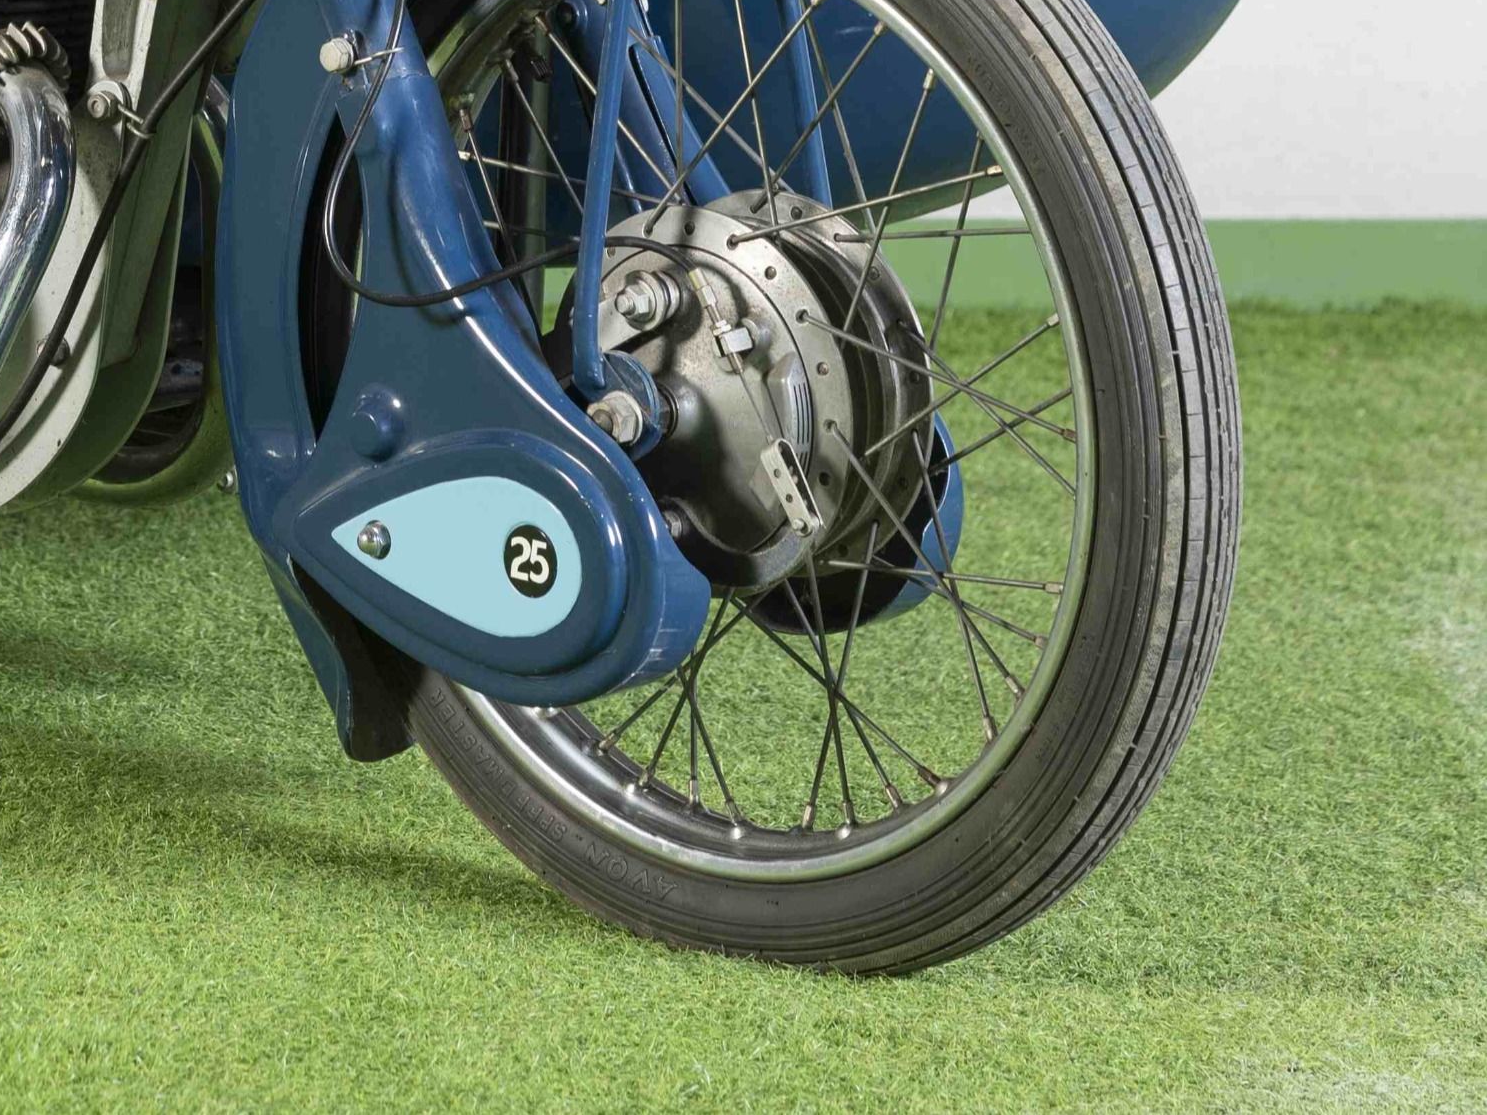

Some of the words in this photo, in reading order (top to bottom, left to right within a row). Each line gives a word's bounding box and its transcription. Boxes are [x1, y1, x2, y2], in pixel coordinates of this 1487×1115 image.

[510, 535, 550, 584] 25
[430, 687, 568, 843] SPEEDMASTER
[583, 841, 679, 903] AVON
